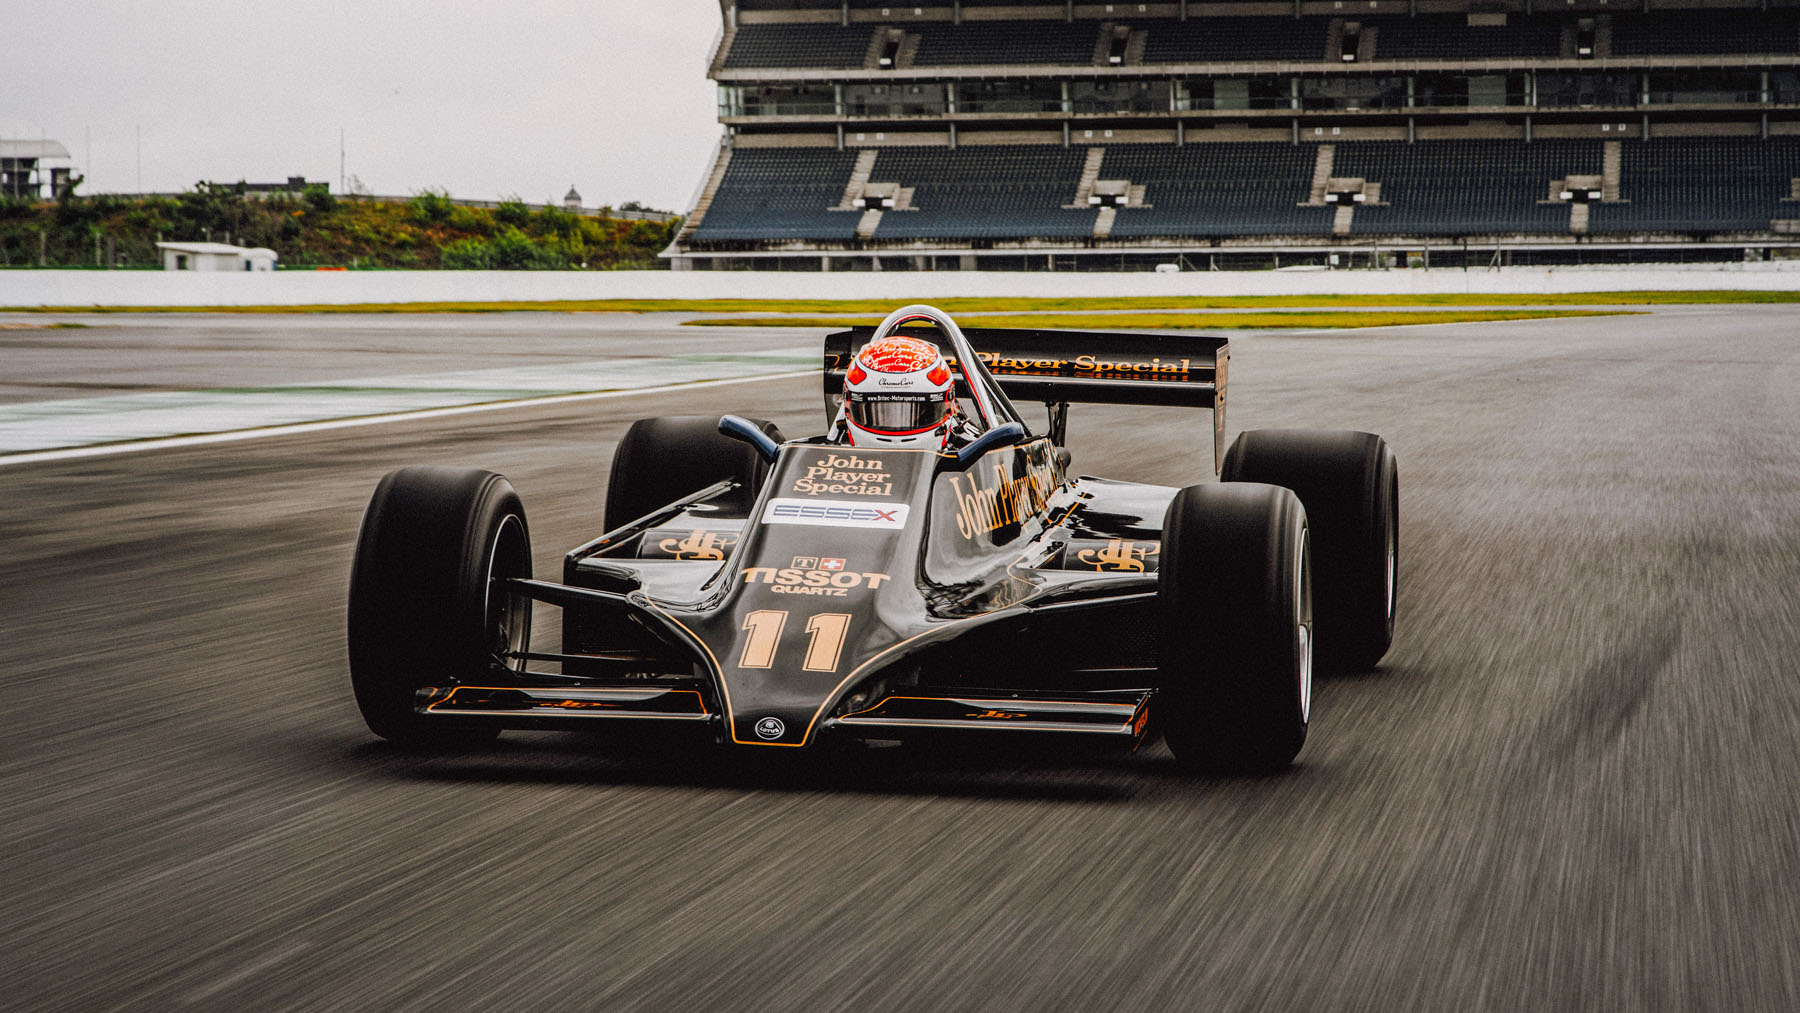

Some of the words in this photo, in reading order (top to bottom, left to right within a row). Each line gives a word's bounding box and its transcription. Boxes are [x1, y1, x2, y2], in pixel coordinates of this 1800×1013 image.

[1073, 355, 1190, 374] Special
[878, 377, 914, 386] ChromeCars
[817, 454, 883, 470] John
[807, 466, 891, 483] Player
[793, 478, 893, 496] Special
[773, 504, 898, 522] ESSEX
[949, 472, 1003, 540] John
[740, 567, 891, 589] TISSOT
[771, 585, 848, 597] QUARTZ
[738, 610, 852, 672] 11
[760, 726, 780, 734] LOTUS
